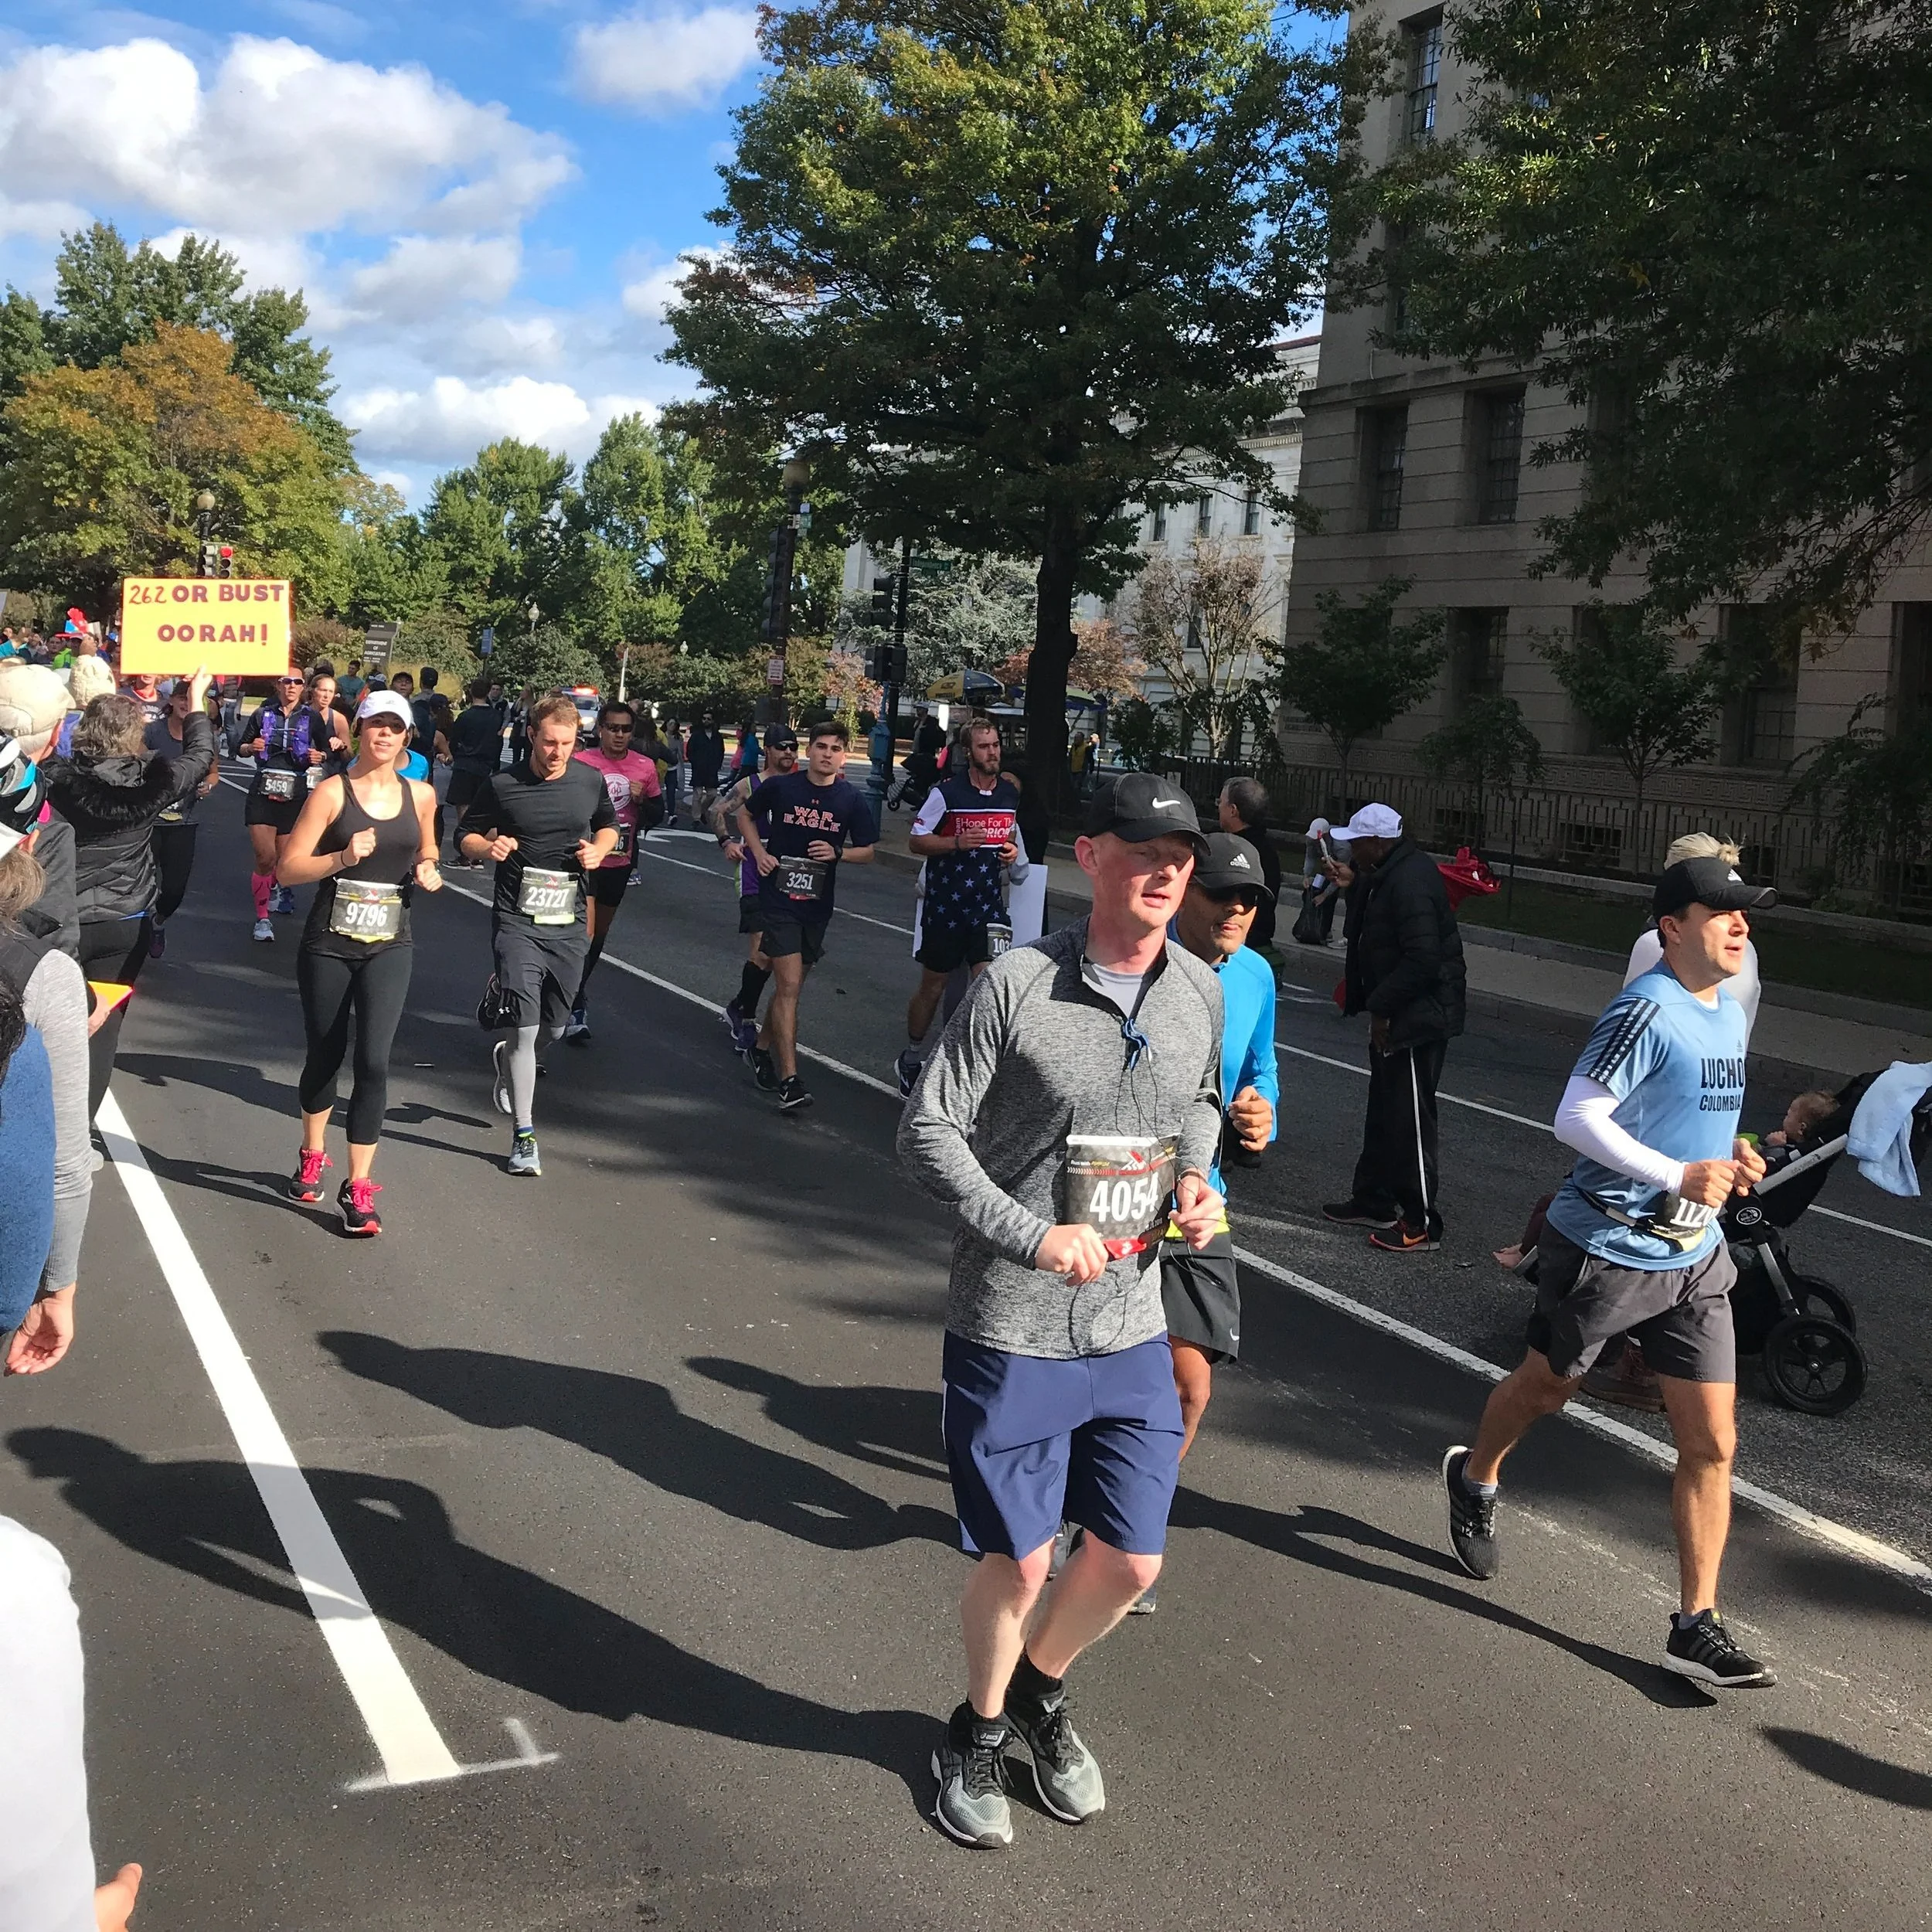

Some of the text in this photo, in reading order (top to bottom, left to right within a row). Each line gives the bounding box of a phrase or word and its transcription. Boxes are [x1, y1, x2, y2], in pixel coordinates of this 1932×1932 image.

[172, 585, 209, 603] OR
[219, 584, 284, 602] BUST
[157, 624, 268, 646] OORAH!
[264, 778, 287, 793] 5459
[783, 813, 841, 832] EAGLE
[794, 805, 834, 822] WAR
[988, 817, 1002, 827] For
[1003, 817, 1014, 827] Th
[786, 872, 814, 890] 3251
[526, 886, 570, 908] 23727
[345, 902, 388, 927] 9796
[1700, 1057, 1744, 1090] LUCHO
[1089, 1172, 1158, 1223] 4054
